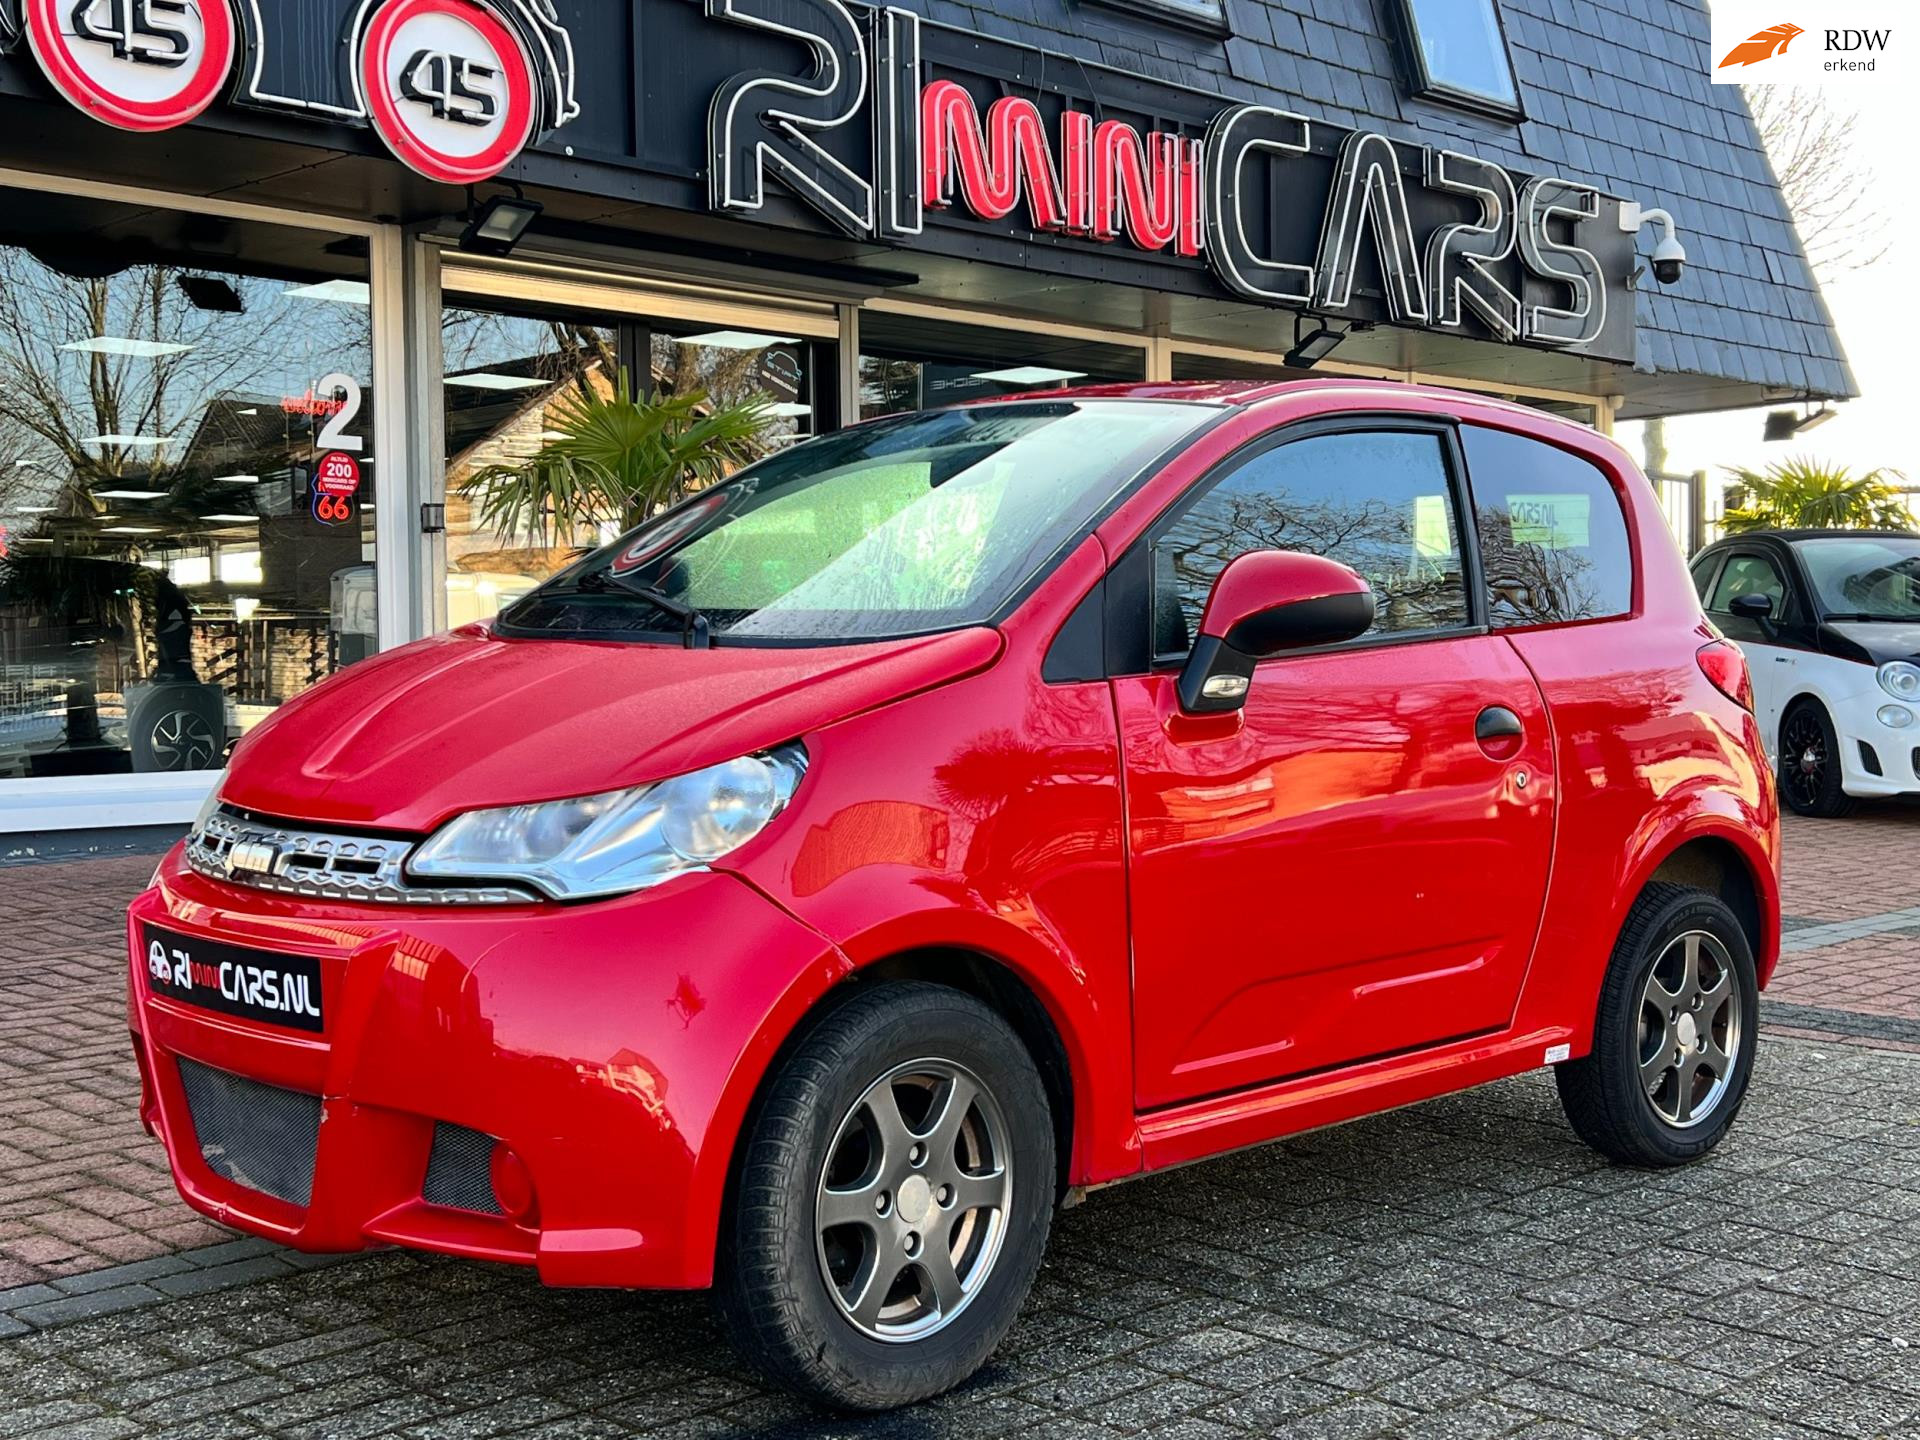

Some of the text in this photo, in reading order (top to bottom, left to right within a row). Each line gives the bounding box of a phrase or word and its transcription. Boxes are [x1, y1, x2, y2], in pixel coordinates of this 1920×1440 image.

[70, 0, 197, 68] 45
[399, 49, 503, 128] 45
[316, 373, 363, 451] 2
[326, 462, 353, 478] 200
[318, 495, 349, 520] 66
